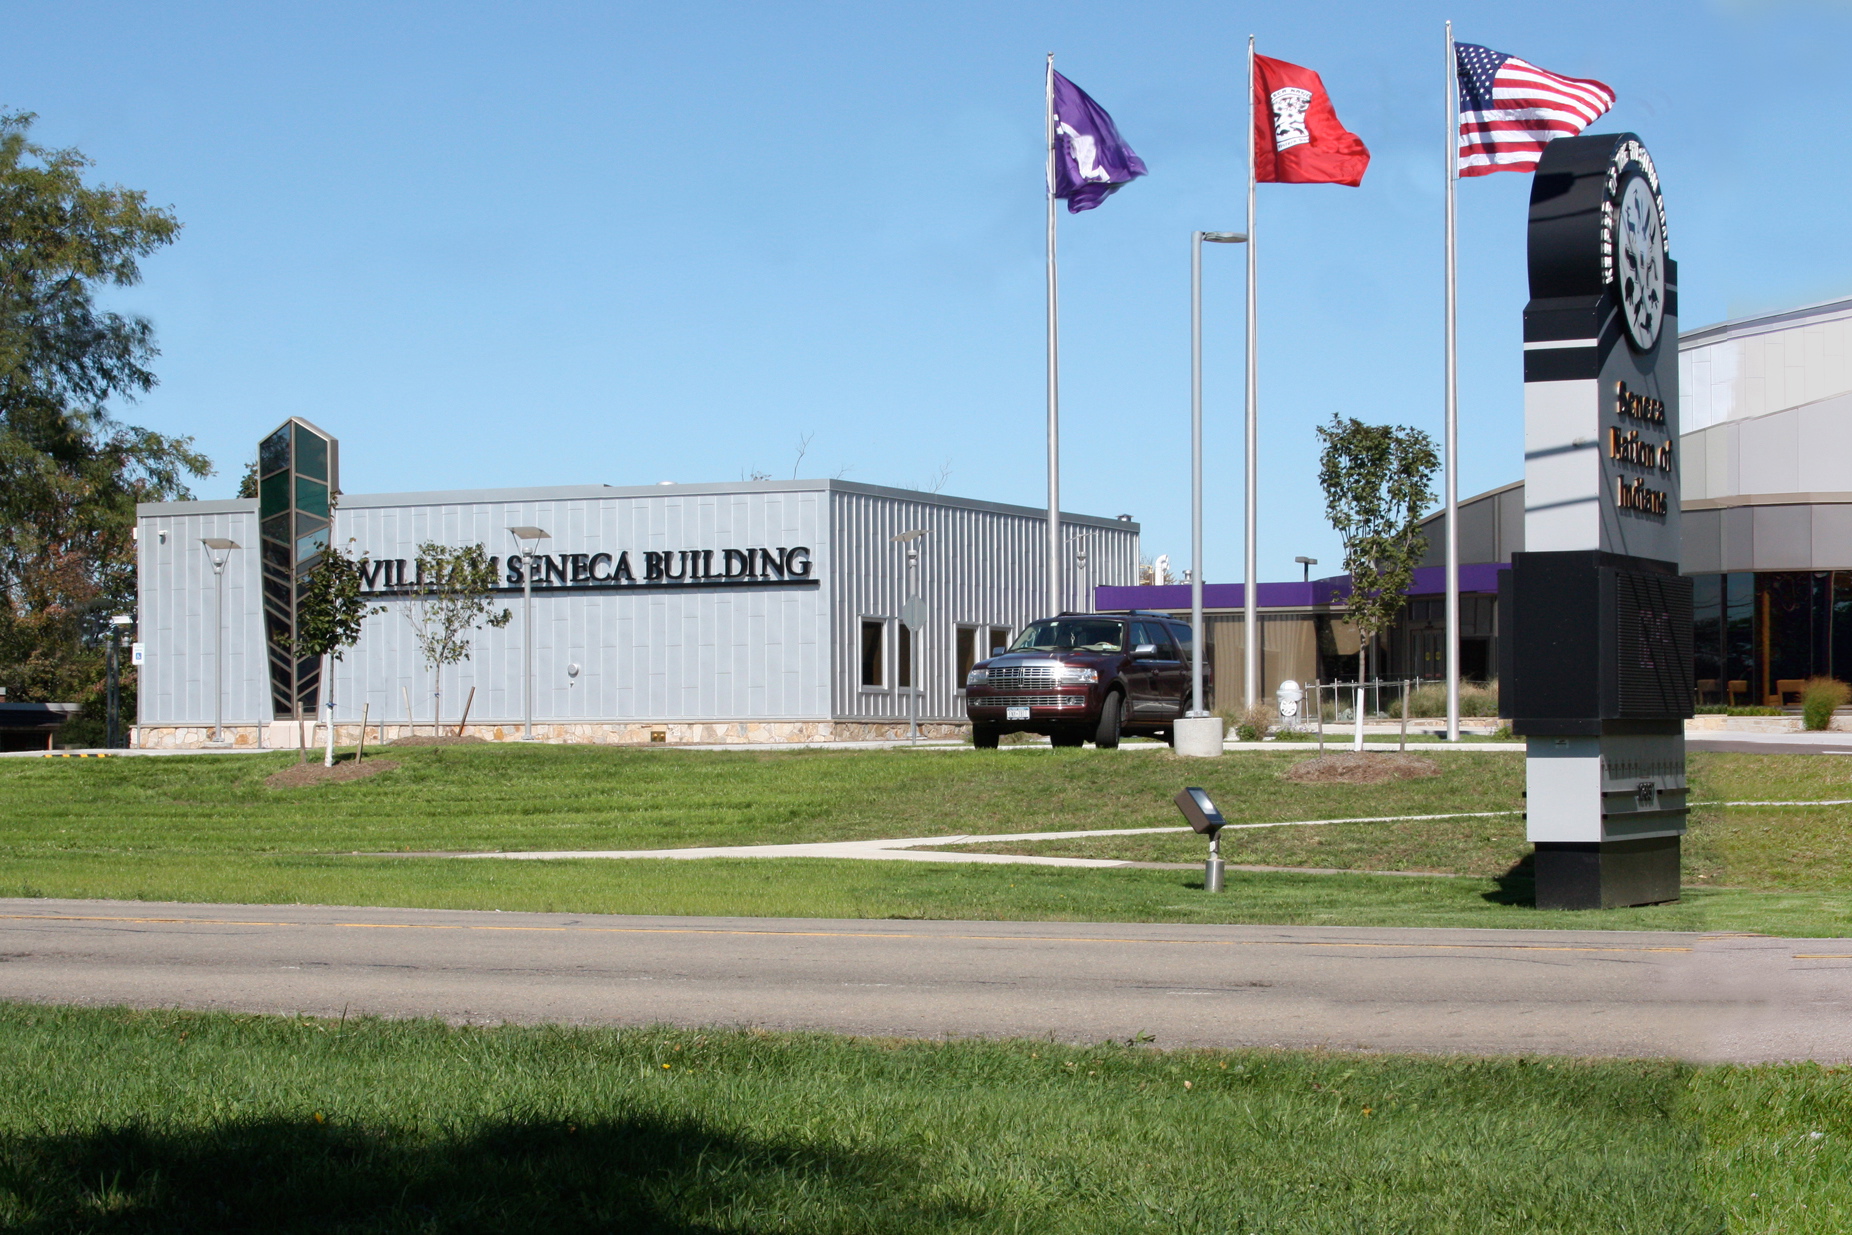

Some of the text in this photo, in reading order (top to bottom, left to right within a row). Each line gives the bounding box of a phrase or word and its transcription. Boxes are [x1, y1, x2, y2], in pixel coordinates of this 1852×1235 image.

[1606, 166, 1618, 197] OF
[1616, 381, 1665, 426] Seneca
[1610, 426, 1672, 472] Nation of
[1617, 474, 1668, 517] Indians
[506, 551, 636, 584] SENECA
[643, 546, 813, 580] BUILDING
